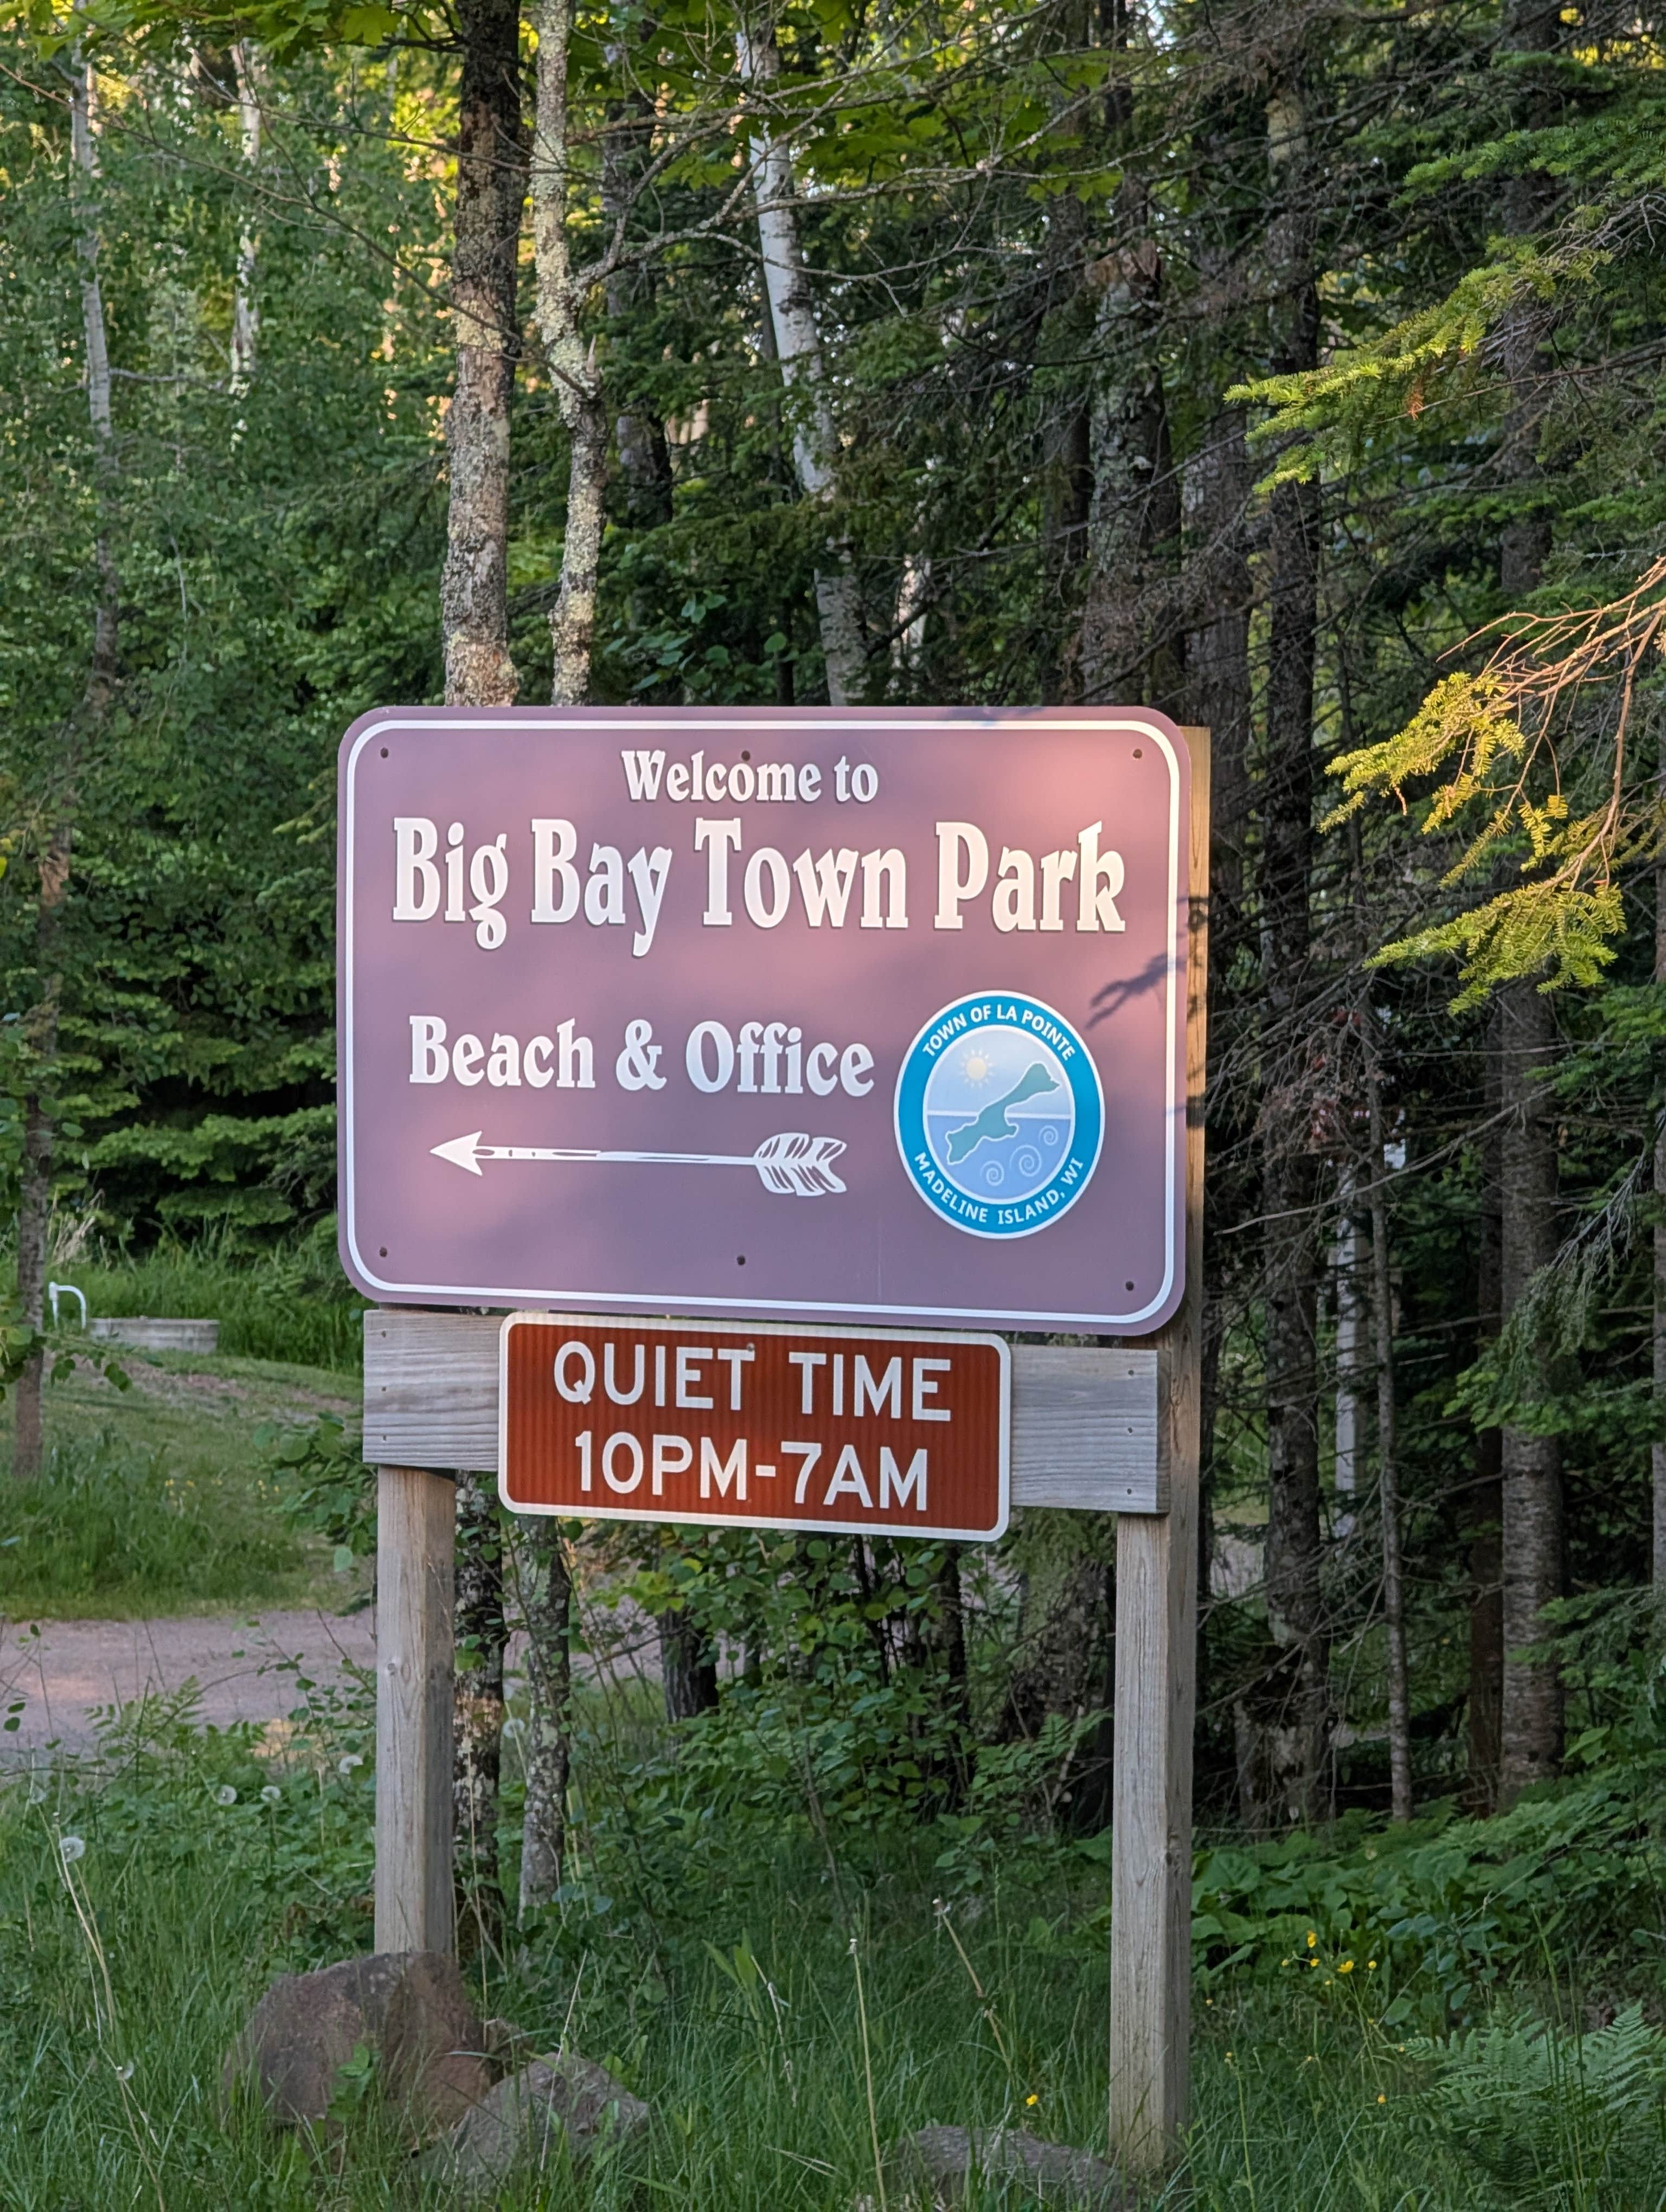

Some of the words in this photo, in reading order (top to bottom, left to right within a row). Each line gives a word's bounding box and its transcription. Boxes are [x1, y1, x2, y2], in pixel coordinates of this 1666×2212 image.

[621, 750, 822, 802] Welcome
[834, 755, 879, 802] to
[392, 817, 508, 950] Big
[530, 819, 672, 957] Bay
[695, 818, 909, 929] Town
[933, 821, 1126, 933] Park
[409, 1015, 595, 1089] Beach
[615, 1019, 667, 1091] &
[685, 1020, 874, 1095] Office
[922, 1013, 967, 1057] TOWN
[970, 1005, 991, 1023] OF
[997, 1005, 1017, 1021] LA
[1021, 1011, 1077, 1060] POINTE
[914, 1152, 988, 1223] MADELINE
[998, 1191, 1065, 1225] ISLAND,
[1061, 1157, 1084, 1186] WI
[552, 1341, 755, 1411] QUIET
[789, 1352, 952, 1422] TIME
[575, 1430, 928, 1512] 10PM-7AM
